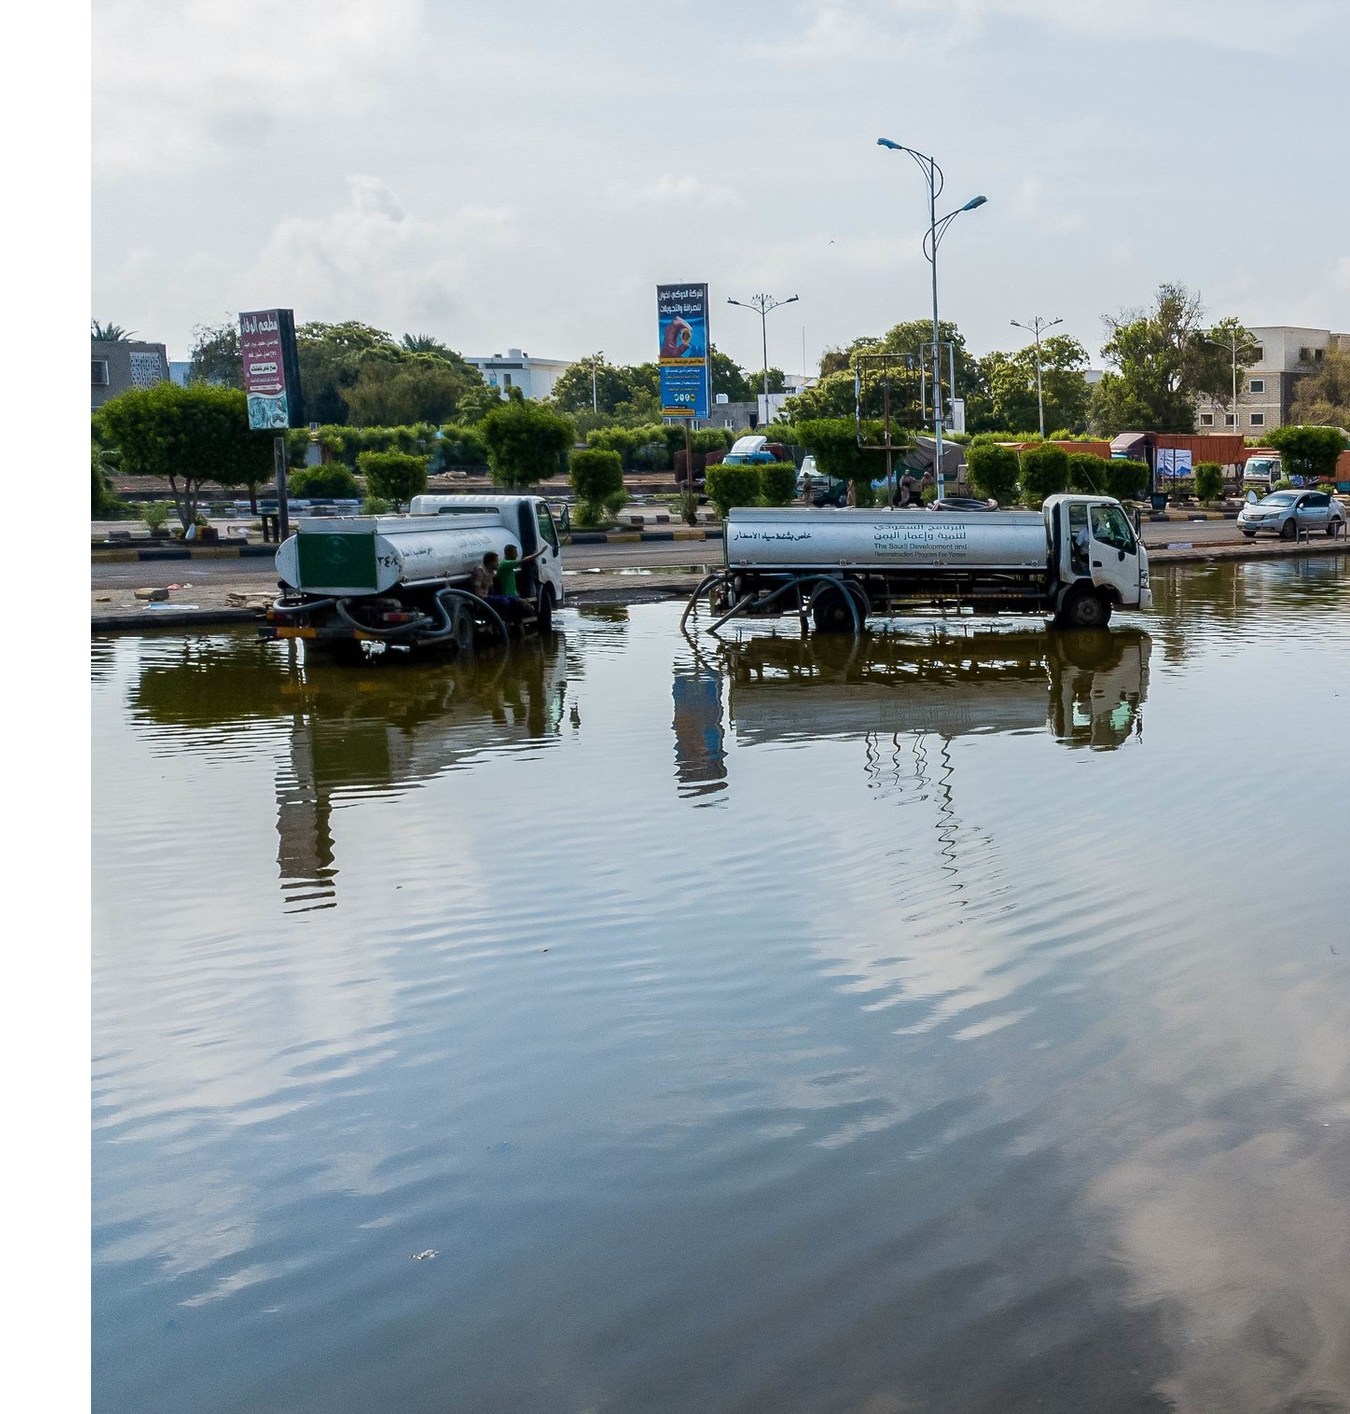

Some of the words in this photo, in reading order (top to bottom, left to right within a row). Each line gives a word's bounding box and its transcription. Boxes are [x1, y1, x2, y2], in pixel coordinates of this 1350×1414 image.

[689, 289, 703, 299] شركة
[258, 314, 278, 334] مطعم
[794, 532, 812, 541] خاص
[874, 532, 900, 541] اليمن
[903, 532, 934, 541] وإعمار
[937, 532, 966, 541] لتنمية
[909, 543, 953, 551] Development
